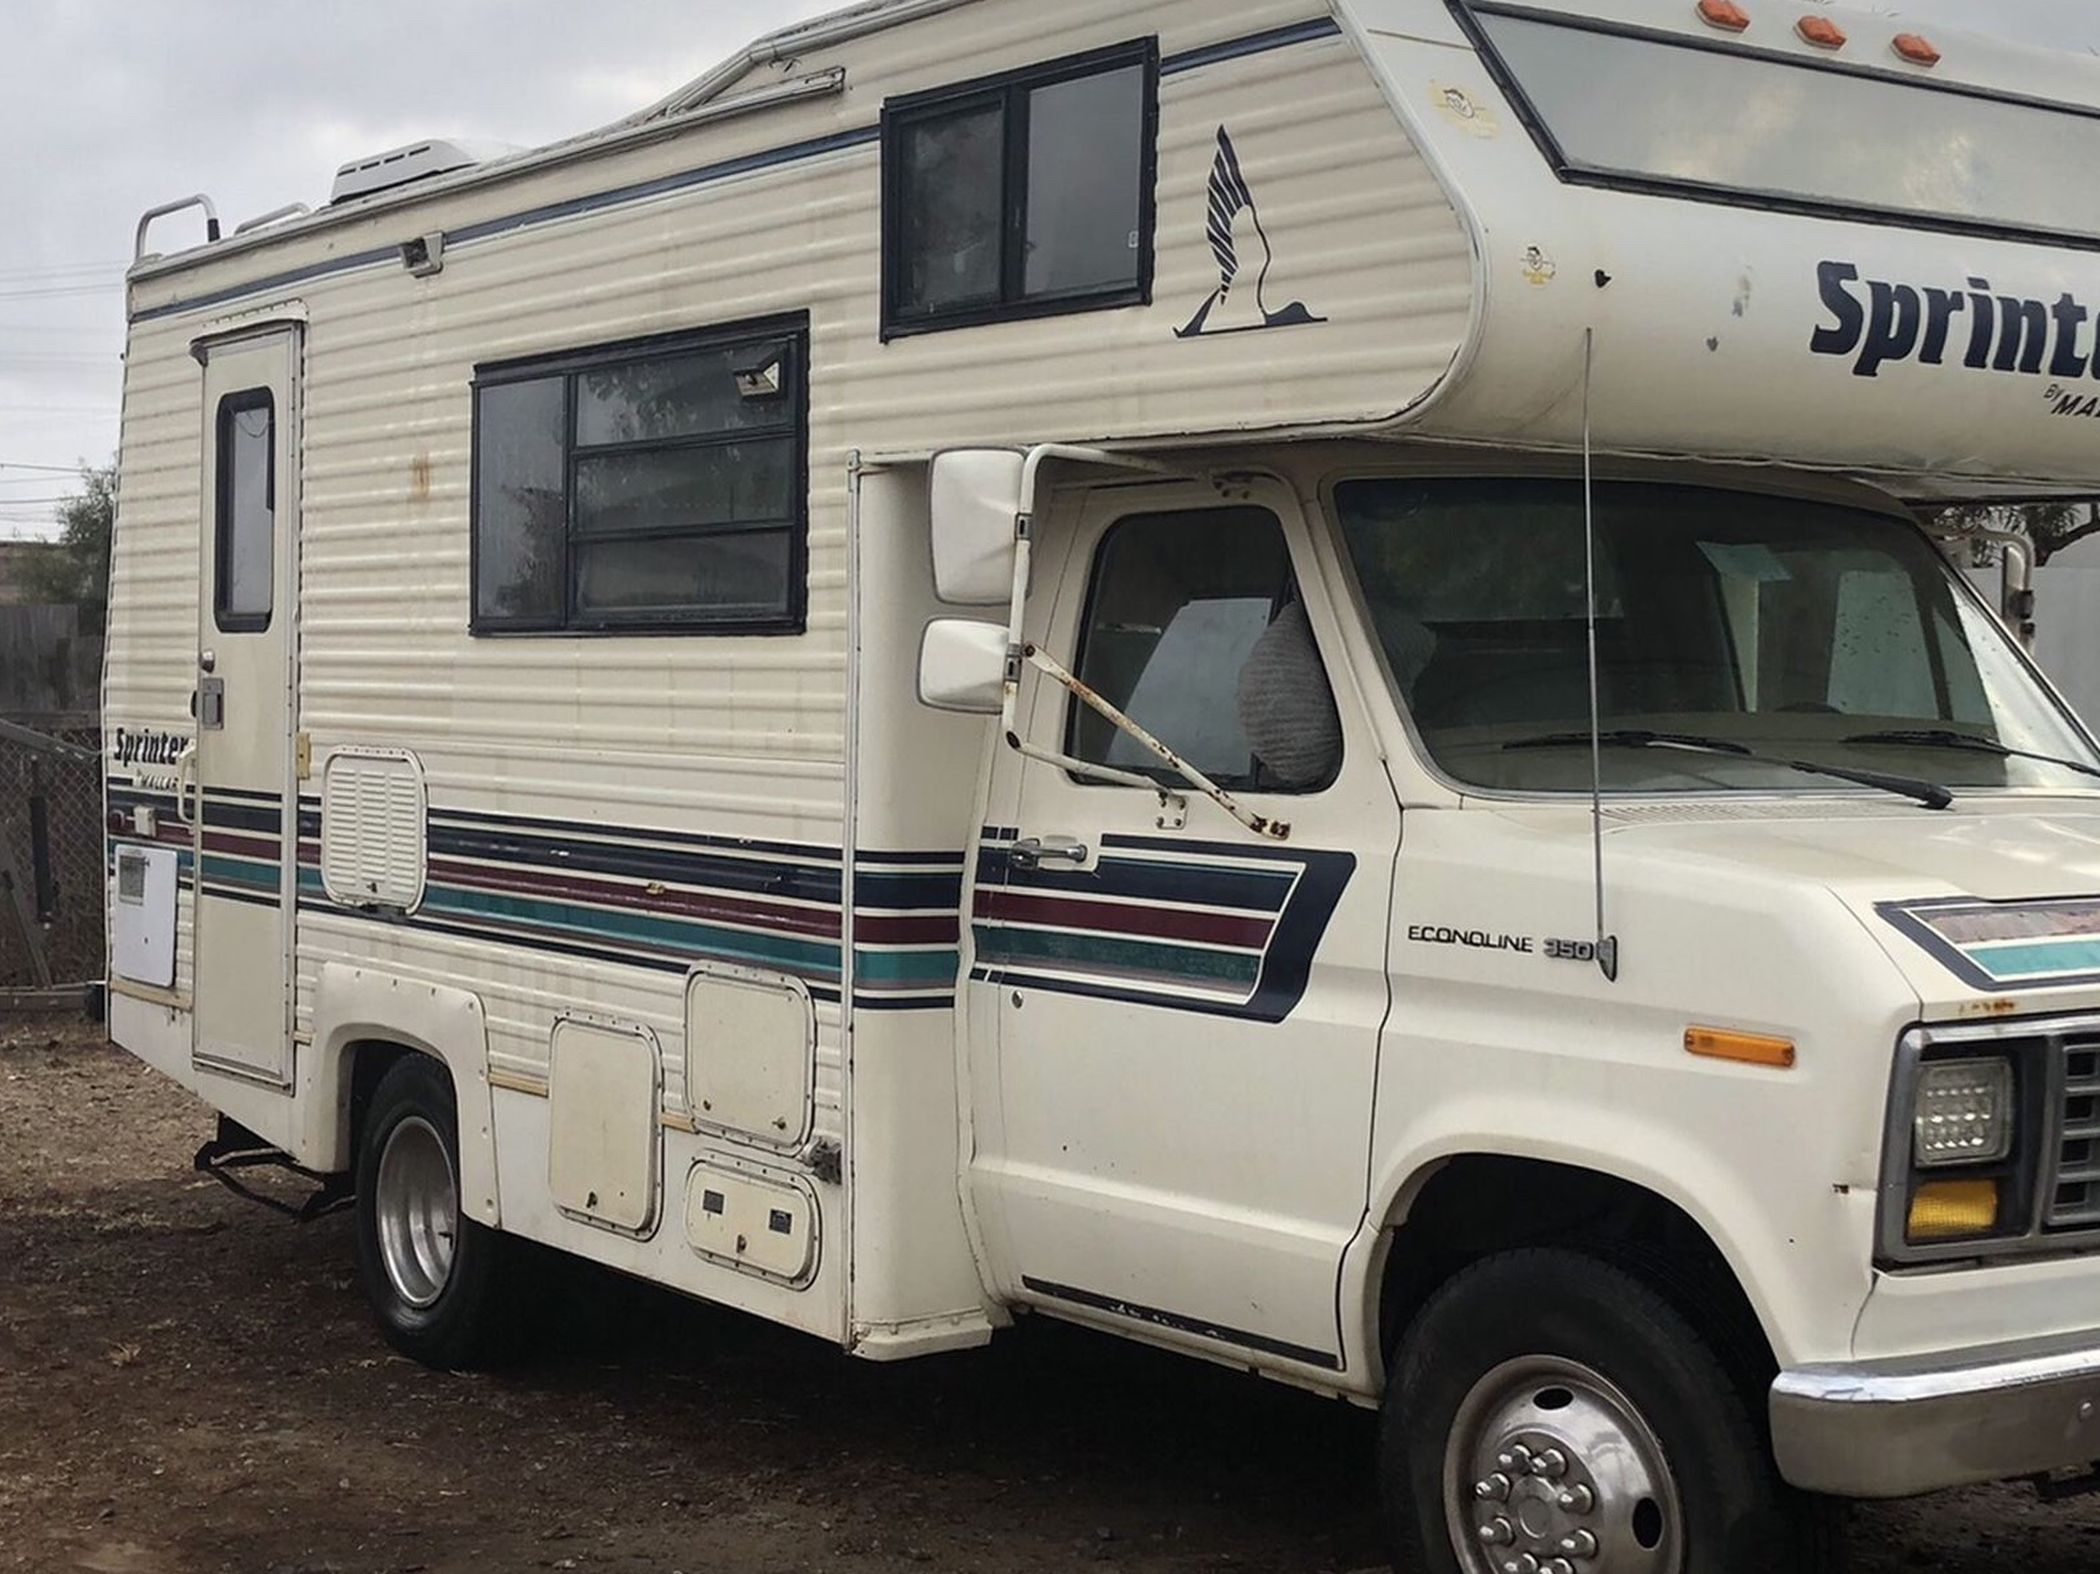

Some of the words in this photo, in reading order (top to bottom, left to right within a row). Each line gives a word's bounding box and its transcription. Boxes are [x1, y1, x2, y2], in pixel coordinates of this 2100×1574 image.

[1809, 260, 2100, 380] Sprint
[1407, 925, 1533, 953] ECONOLINE
[1542, 937, 1595, 961] 350
